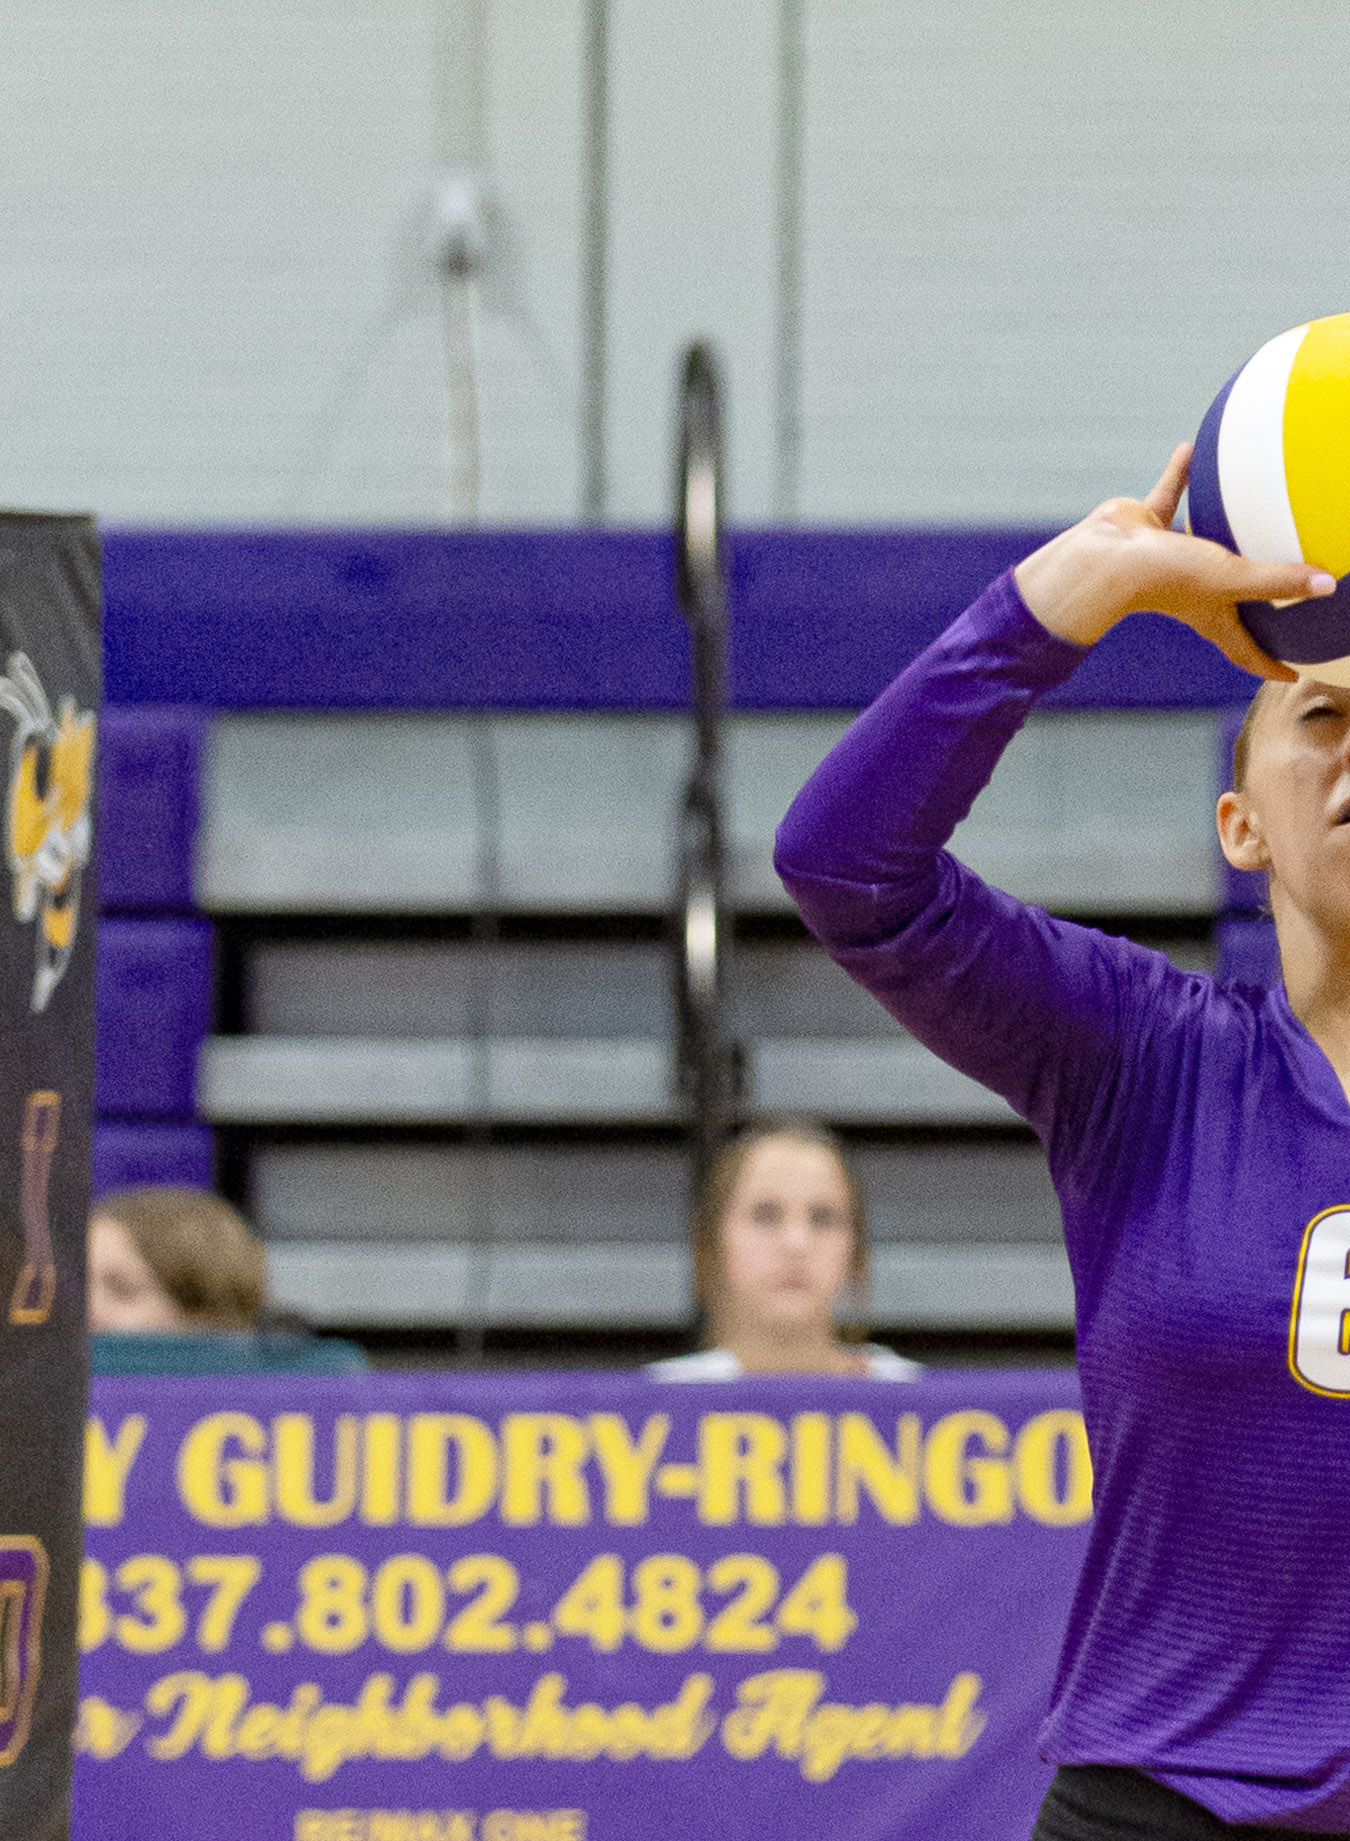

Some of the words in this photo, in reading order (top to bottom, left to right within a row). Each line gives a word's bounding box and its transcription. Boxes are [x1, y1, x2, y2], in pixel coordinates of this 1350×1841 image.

[177, 1410, 1095, 1528] GUIDRY-RINGO
[146, 1672, 713, 1781] Neighborhood
[720, 1669, 985, 1781] Agent
